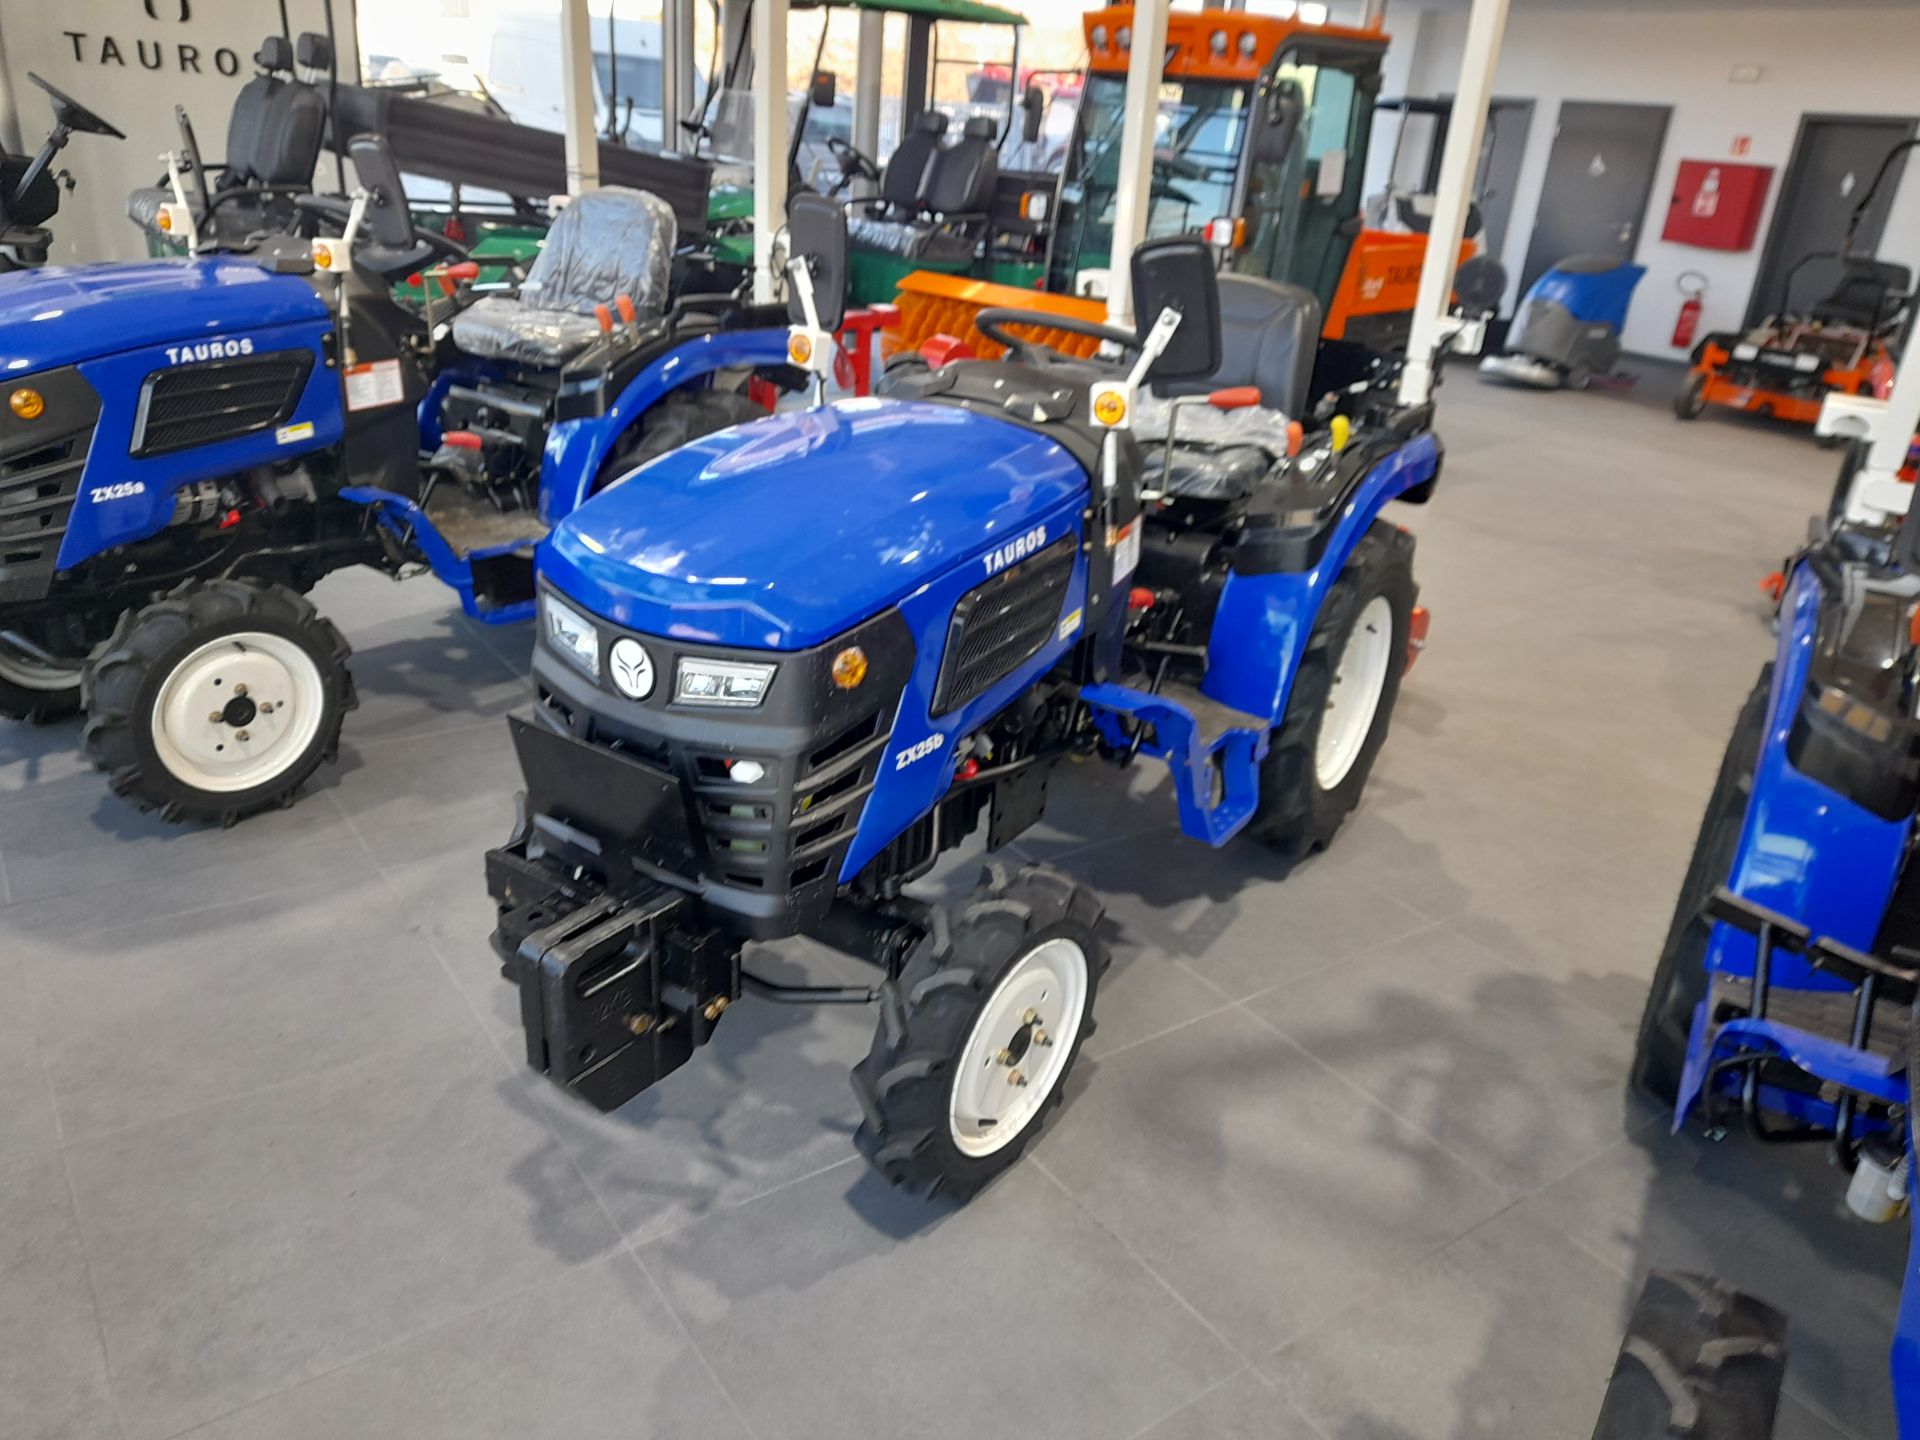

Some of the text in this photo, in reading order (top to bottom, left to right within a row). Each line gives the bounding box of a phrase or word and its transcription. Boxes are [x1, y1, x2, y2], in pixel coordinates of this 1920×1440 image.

[165, 337, 254, 364] TAUROS
[982, 525, 1047, 575] TAUROS
[895, 731, 945, 771] ZX25b
